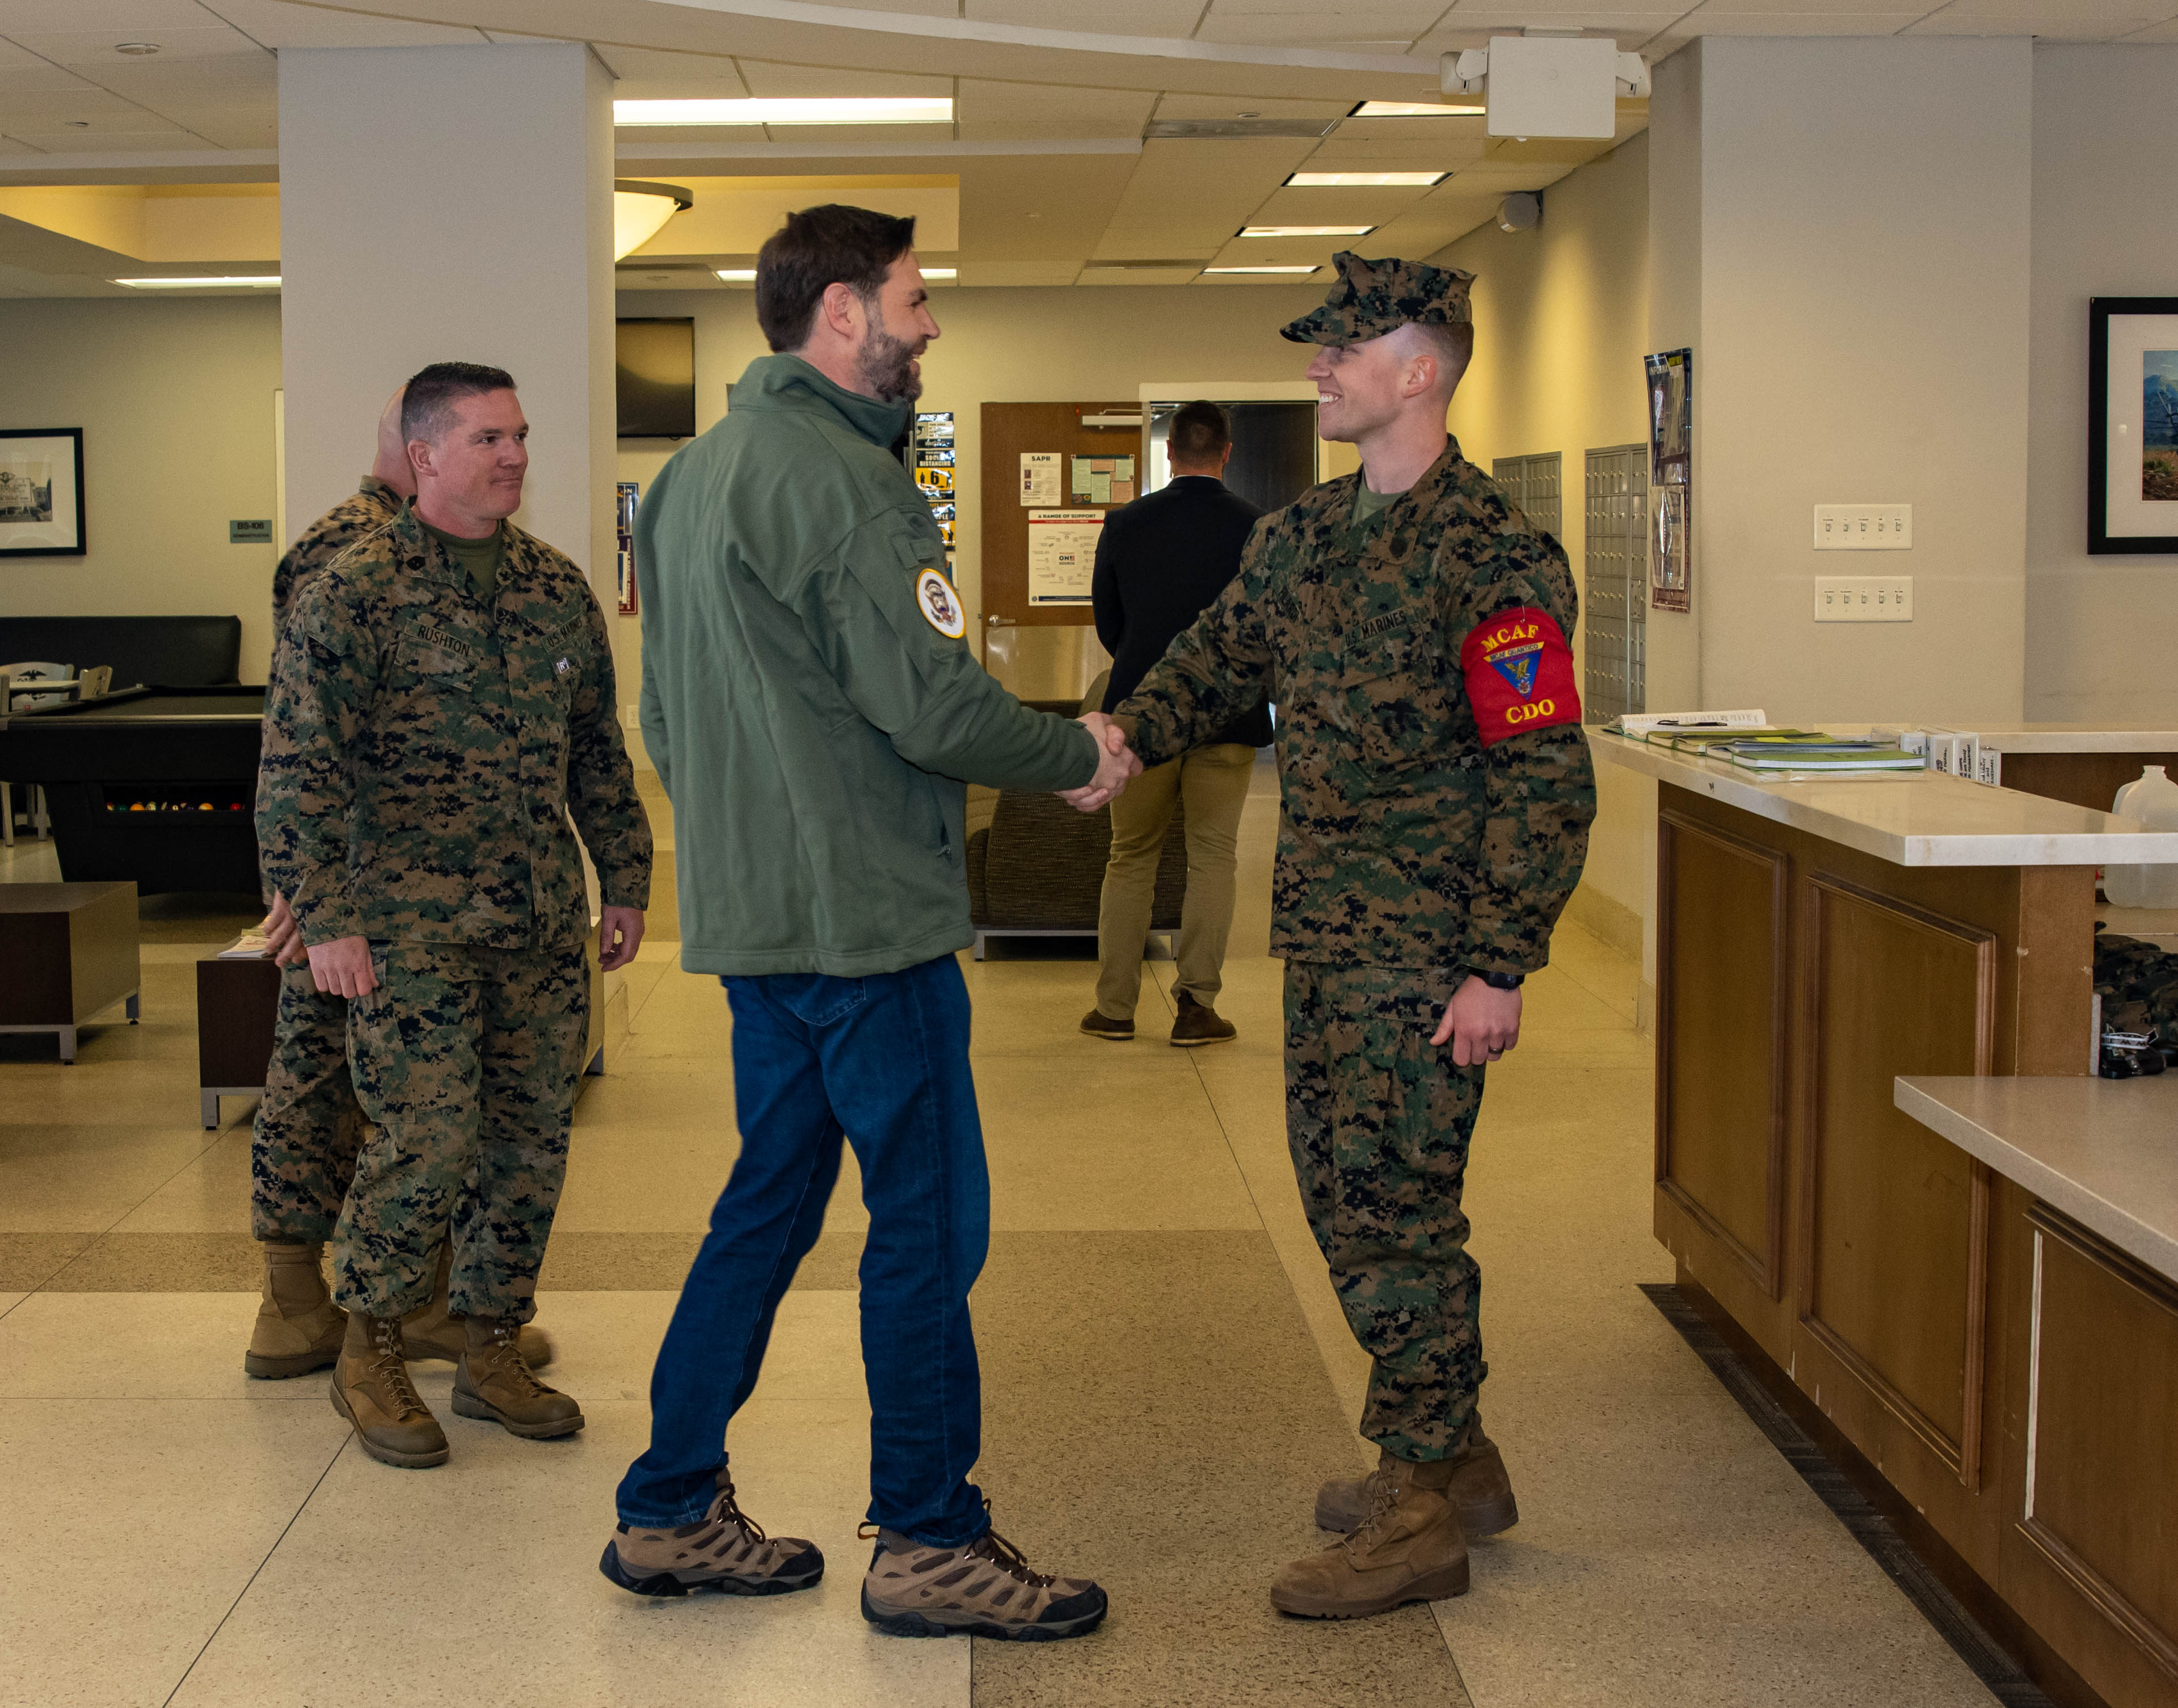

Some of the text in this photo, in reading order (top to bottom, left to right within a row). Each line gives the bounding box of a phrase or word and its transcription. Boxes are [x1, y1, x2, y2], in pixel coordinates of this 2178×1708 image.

[930, 471, 940, 485] 6
[418, 625, 470, 657] RUSHTON
[1345, 610, 1407, 646] U.S. MARINES
[1481, 624, 1539, 652] MCAF
[1507, 644, 1539, 655] QUANTICO
[1505, 699, 1555, 724] CDO
